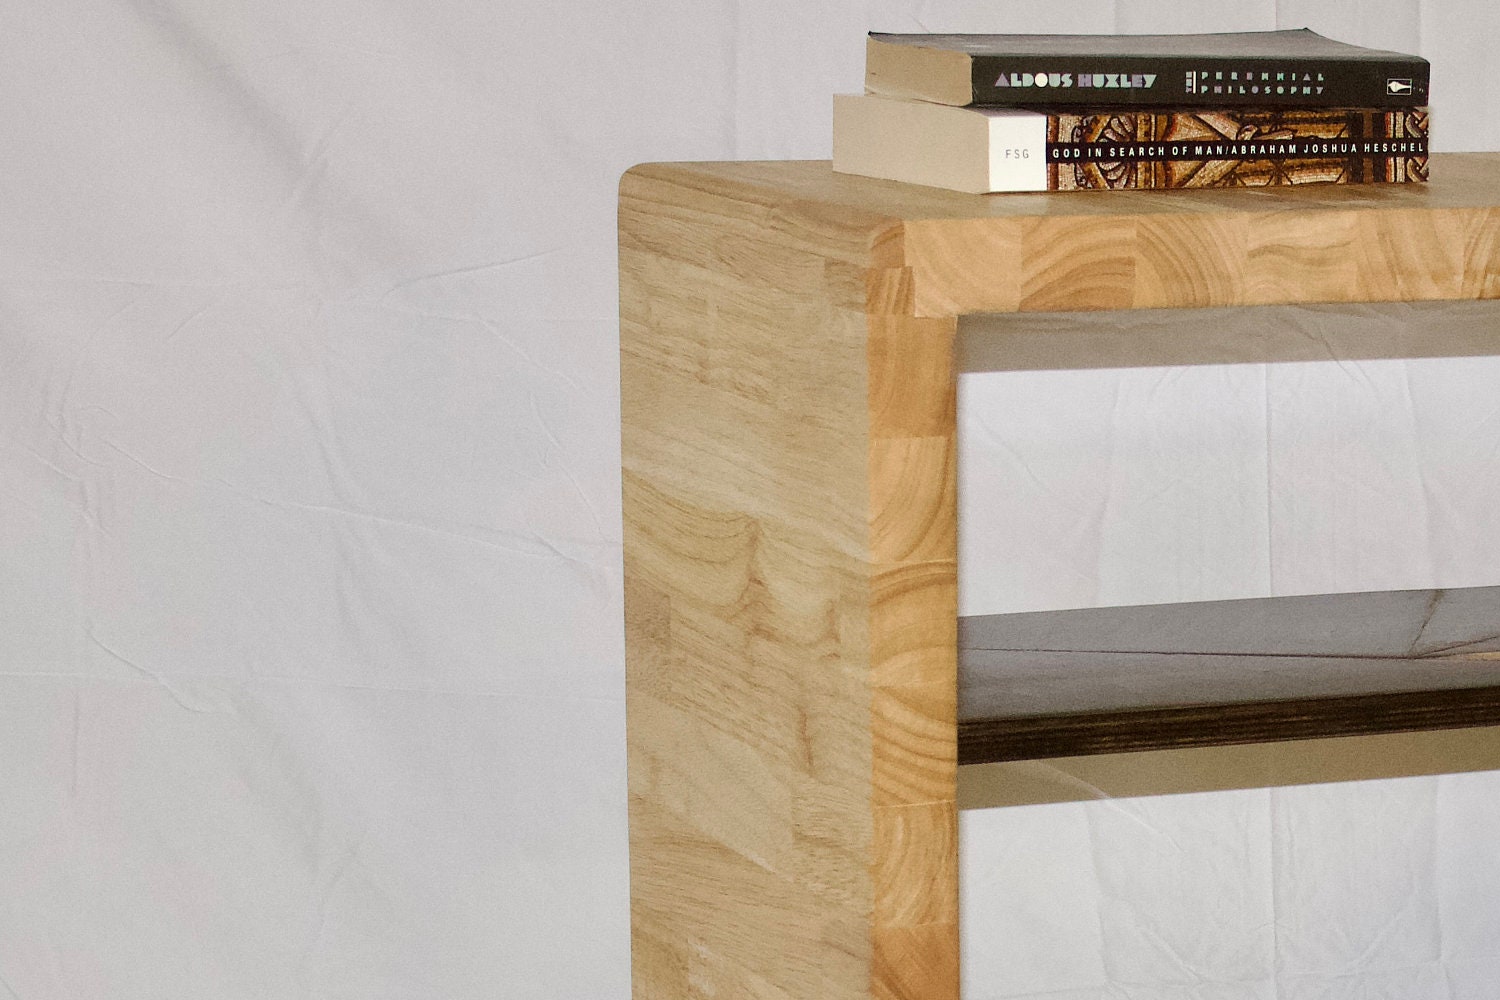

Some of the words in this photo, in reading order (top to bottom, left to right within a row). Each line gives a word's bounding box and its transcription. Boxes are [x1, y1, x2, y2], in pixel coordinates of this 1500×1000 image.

[994, 72, 1073, 88] ALDOUS
[1078, 74, 1157, 88] HUXLEY
[1201, 71, 1324, 81] PERENNIAL
[1201, 85, 1324, 94] PHILOSOPHY
[1005, 148, 1030, 159] FSG
[1052, 148, 1081, 159] GOD
[1088, 148, 1102, 158] IN
[1109, 146, 1165, 157] SEARCH
[1172, 146, 1188, 156] OF
[1303, 143, 1357, 153] JOSHUA
[1364, 142, 1424, 153] HESCHEL
